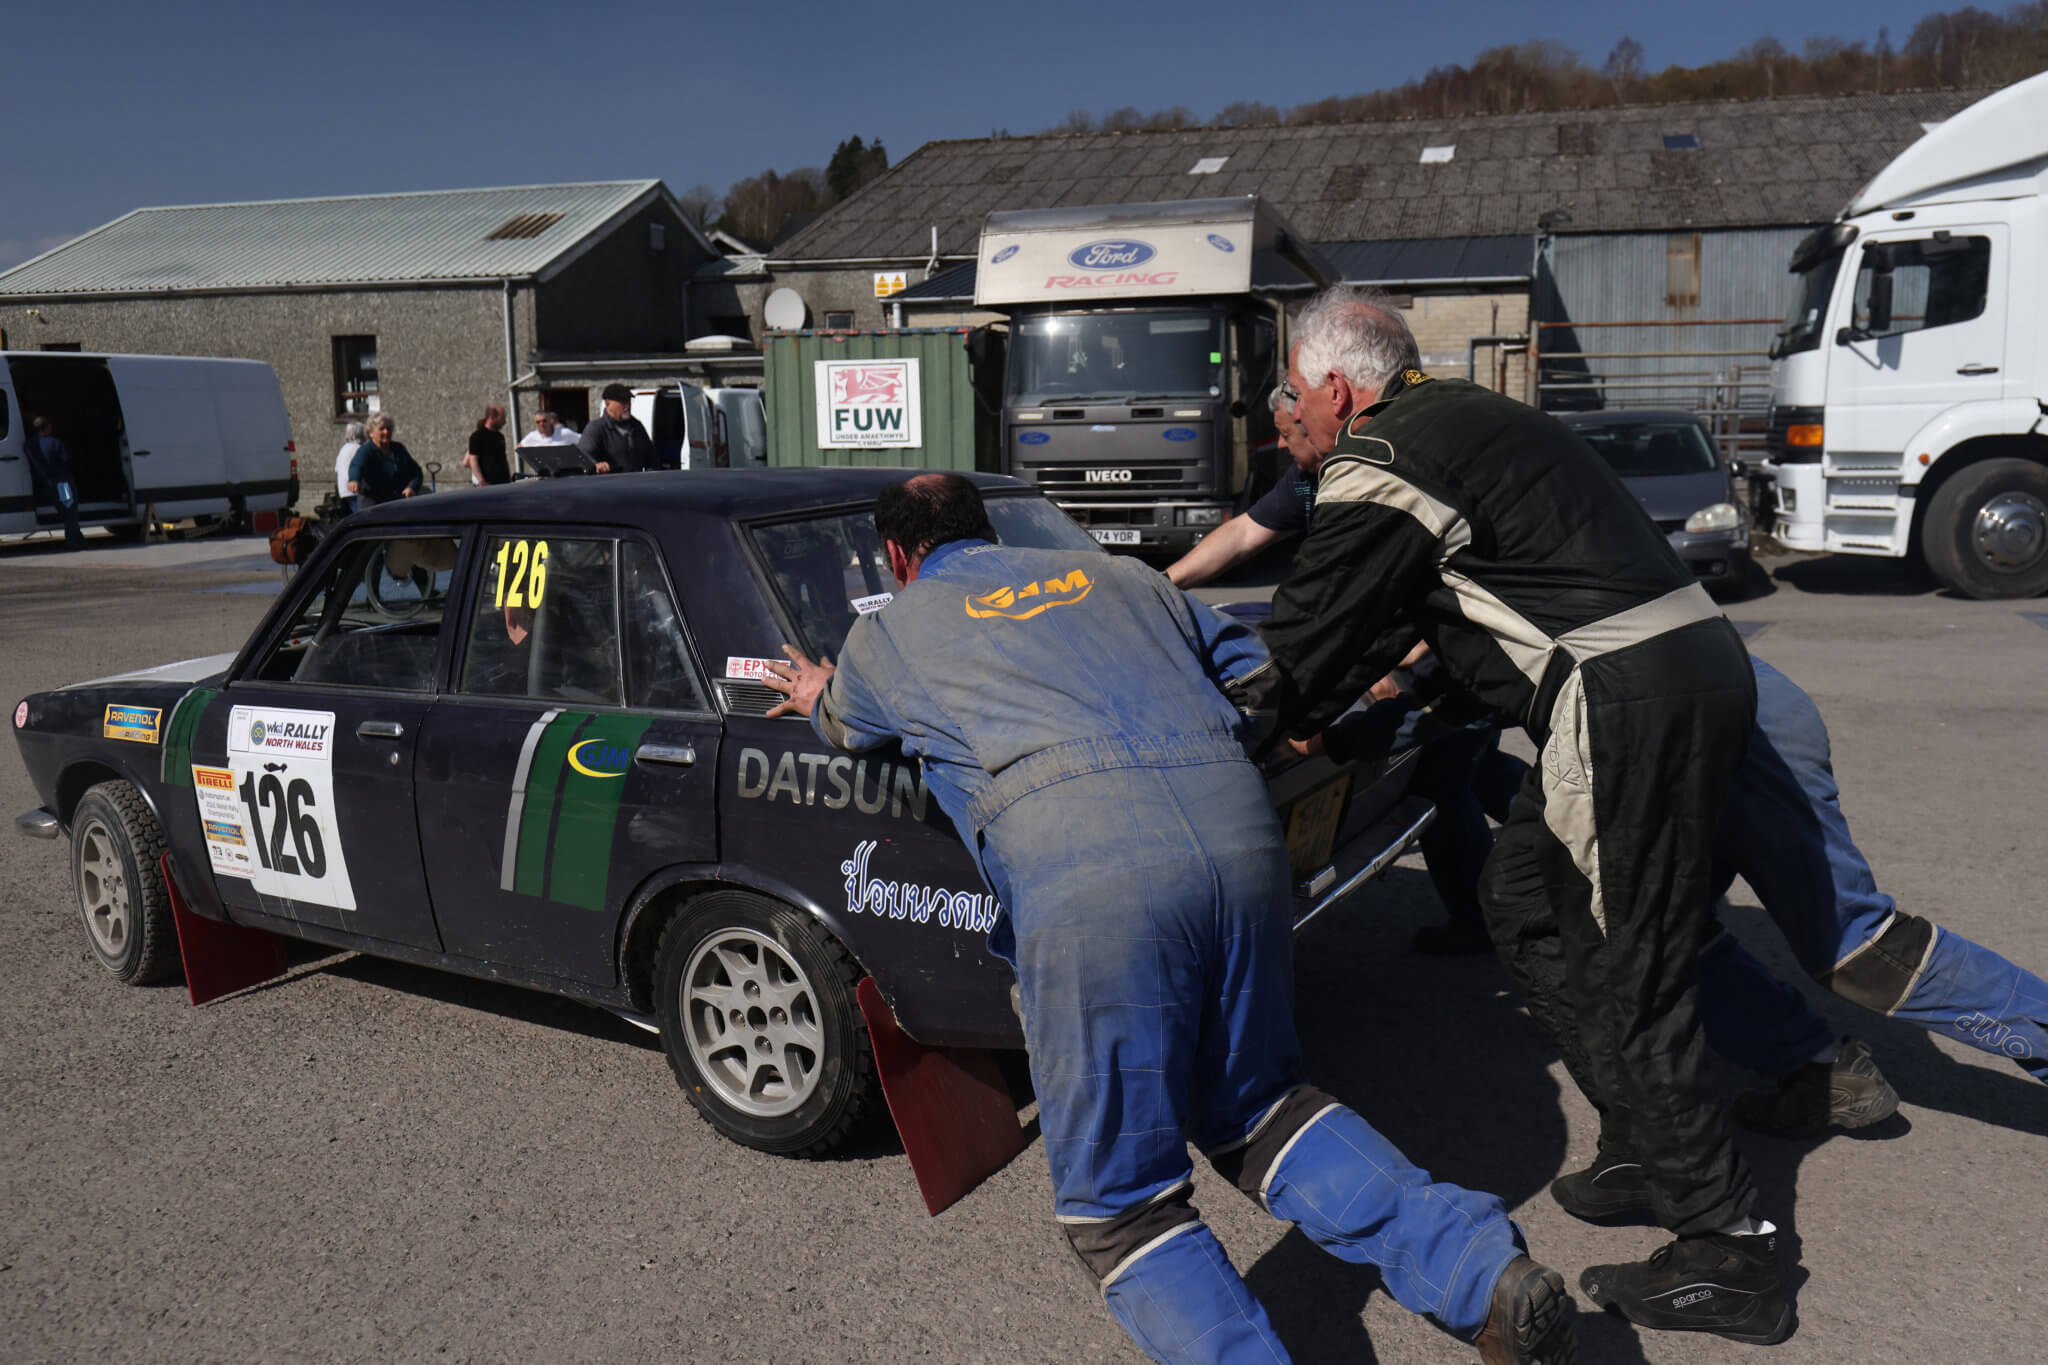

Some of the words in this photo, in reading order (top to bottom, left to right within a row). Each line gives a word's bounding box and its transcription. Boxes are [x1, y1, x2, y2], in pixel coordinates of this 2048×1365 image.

[1085, 243, 1138, 266] Ford
[1044, 272, 1179, 289] RACING
[835, 408, 902, 431] FUW
[1085, 470, 1133, 482] IVECO
[1113, 531, 1134, 542] YOR
[496, 540, 549, 609] 126
[111, 711, 153, 726] RAVENOL
[266, 721, 283, 734] wkd
[284, 723, 328, 740] RALLY
[265, 738, 293, 748] NORTH
[296, 741, 324, 751] WALES
[579, 744, 629, 769] GJM
[197, 770, 233, 789] PIRELLI
[738, 748, 928, 822] DATSUN
[239, 771, 326, 878] 126
